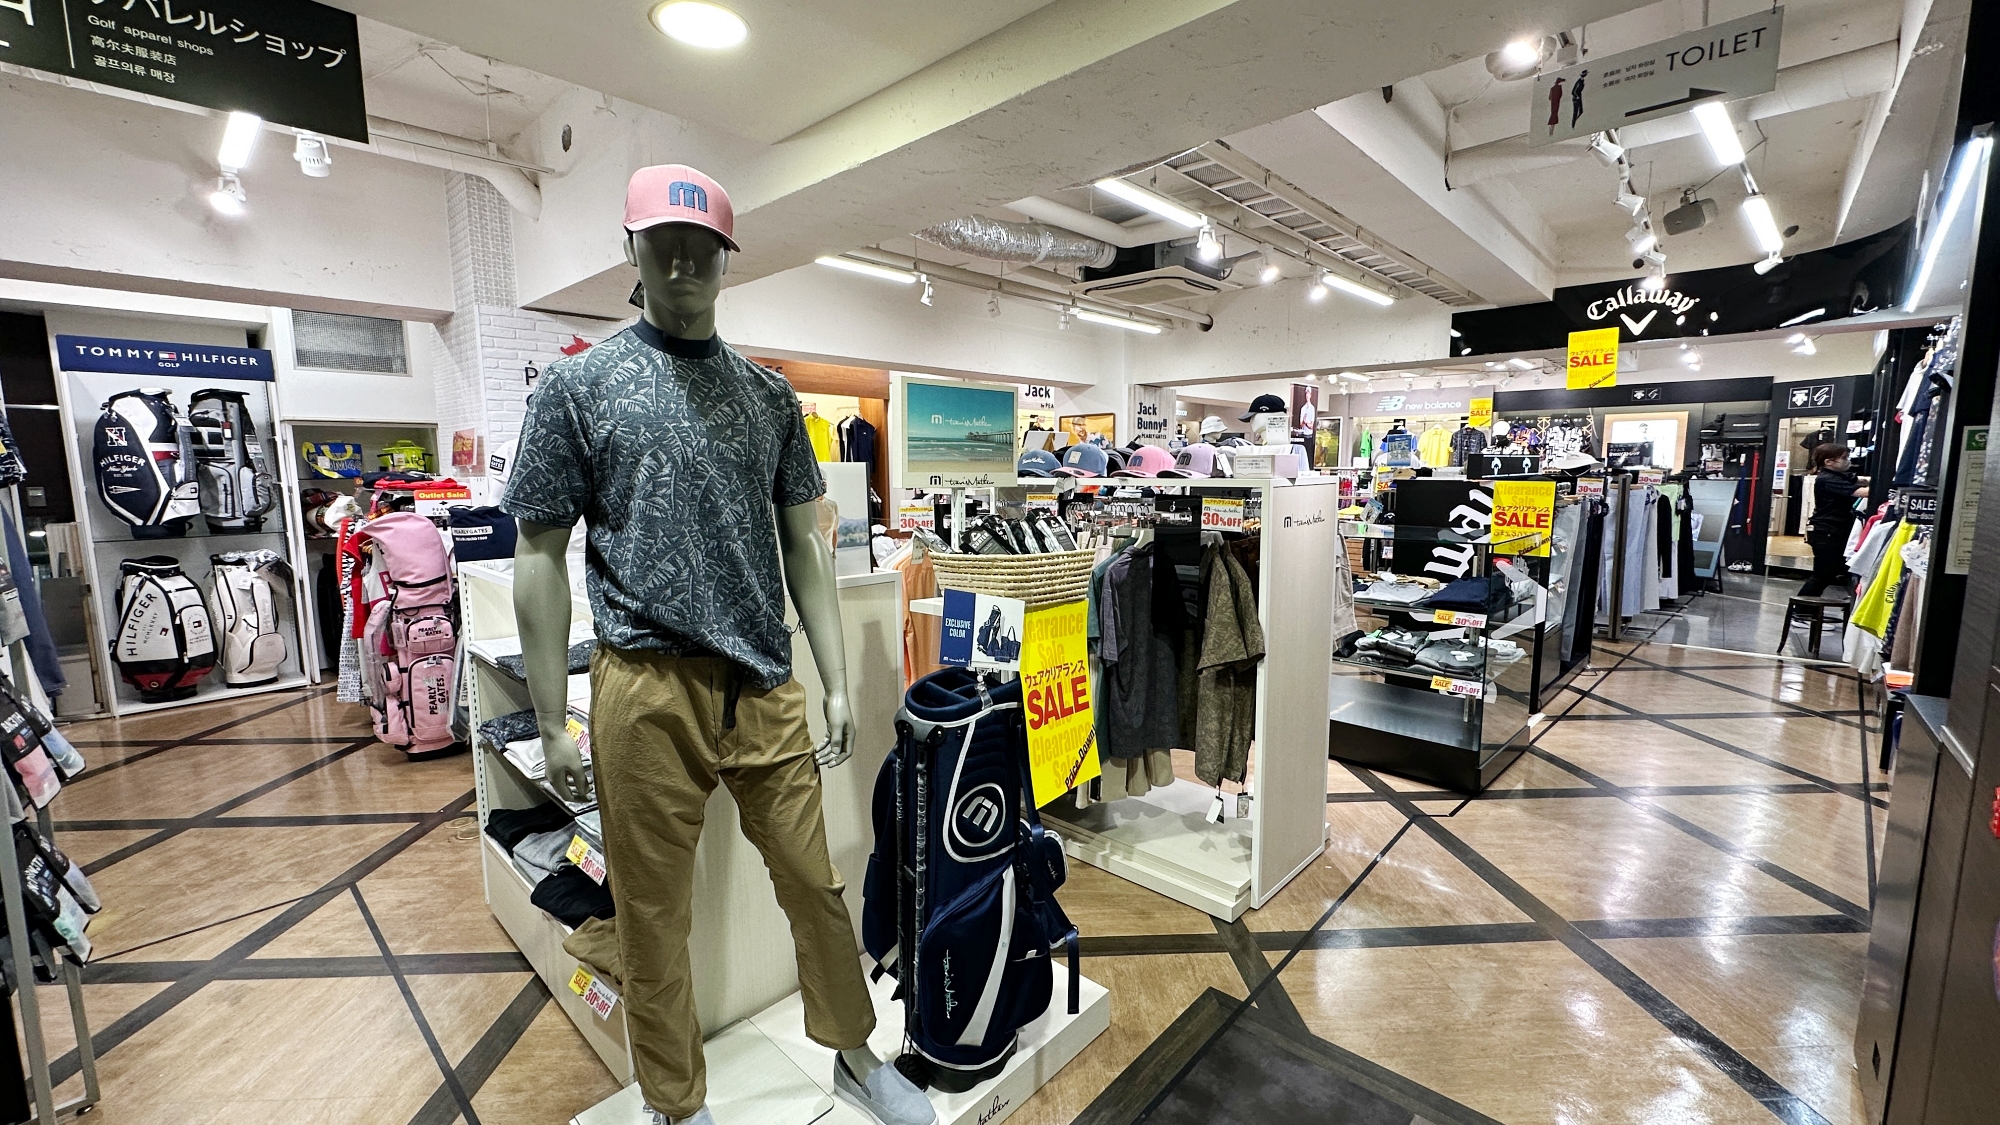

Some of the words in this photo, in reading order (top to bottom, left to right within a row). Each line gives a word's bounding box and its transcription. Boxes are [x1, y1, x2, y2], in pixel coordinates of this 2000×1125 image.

[88, 15, 116, 30] Golf
[123, 26, 172, 45] apparel
[177, 40, 214, 56] shops
[91, 0, 347, 68] パレルショップ
[90, 34, 177, 66] 高尔夫服装店
[1666, 27, 1767, 71] TOILET
[93, 54, 147, 77] 골프의류
[150, 68, 176, 84] 매장
[1587, 285, 1698, 320] Callaway
[76, 345, 153, 360] TOMMY
[182, 352, 258, 366] HILFIGER
[1570, 347, 1615, 356] ウェアクリアランス
[1569, 353, 1615, 368] SALE
[1025, 385, 1051, 398] Jack
[1137, 402, 1157, 416] Jack
[1424, 401, 1462, 410] balance
[1470, 409, 1491, 417] SALE
[100, 454, 146, 468] HILFIGER
[1377, 482, 1390, 490] SA
[1497, 484, 1552, 497] Clearance
[1578, 485, 1602, 493] 30%OFF
[418, 491, 445, 499] Outlet
[446, 491, 467, 499] Sale!
[1910, 499, 1937, 511] SALE
[1202, 512, 1242, 527] 30%OFF
[1493, 511, 1550, 529] SALE
[1907, 511, 1935, 520] Non-disco
[900, 518, 934, 529] 30%OFF
[1884, 581, 1901, 604] Calla
[126, 593, 158, 656] HILFIGER
[945, 617, 971, 630] EXCLUSIVE
[1024, 612, 1084, 644] learance
[1455, 617, 1484, 627] 30%OFF
[949, 628, 966, 638] COLOR
[1025, 659, 1086, 688] ウェアクリアランス
[1434, 680, 1450, 688] SALE
[1452, 684, 1481, 695] 30%OFF
[428, 685, 438, 715] PEARLY
[1027, 675, 1090, 731] SALE
[1, 711, 26, 734] BN3TH
[1064, 759, 1080, 791] Price
[1079, 724, 1096, 759] Down!
[581, 856, 605, 883] 30%OFF
[573, 974, 588, 991] SALE
[585, 987, 611, 1016] 30%OFF
